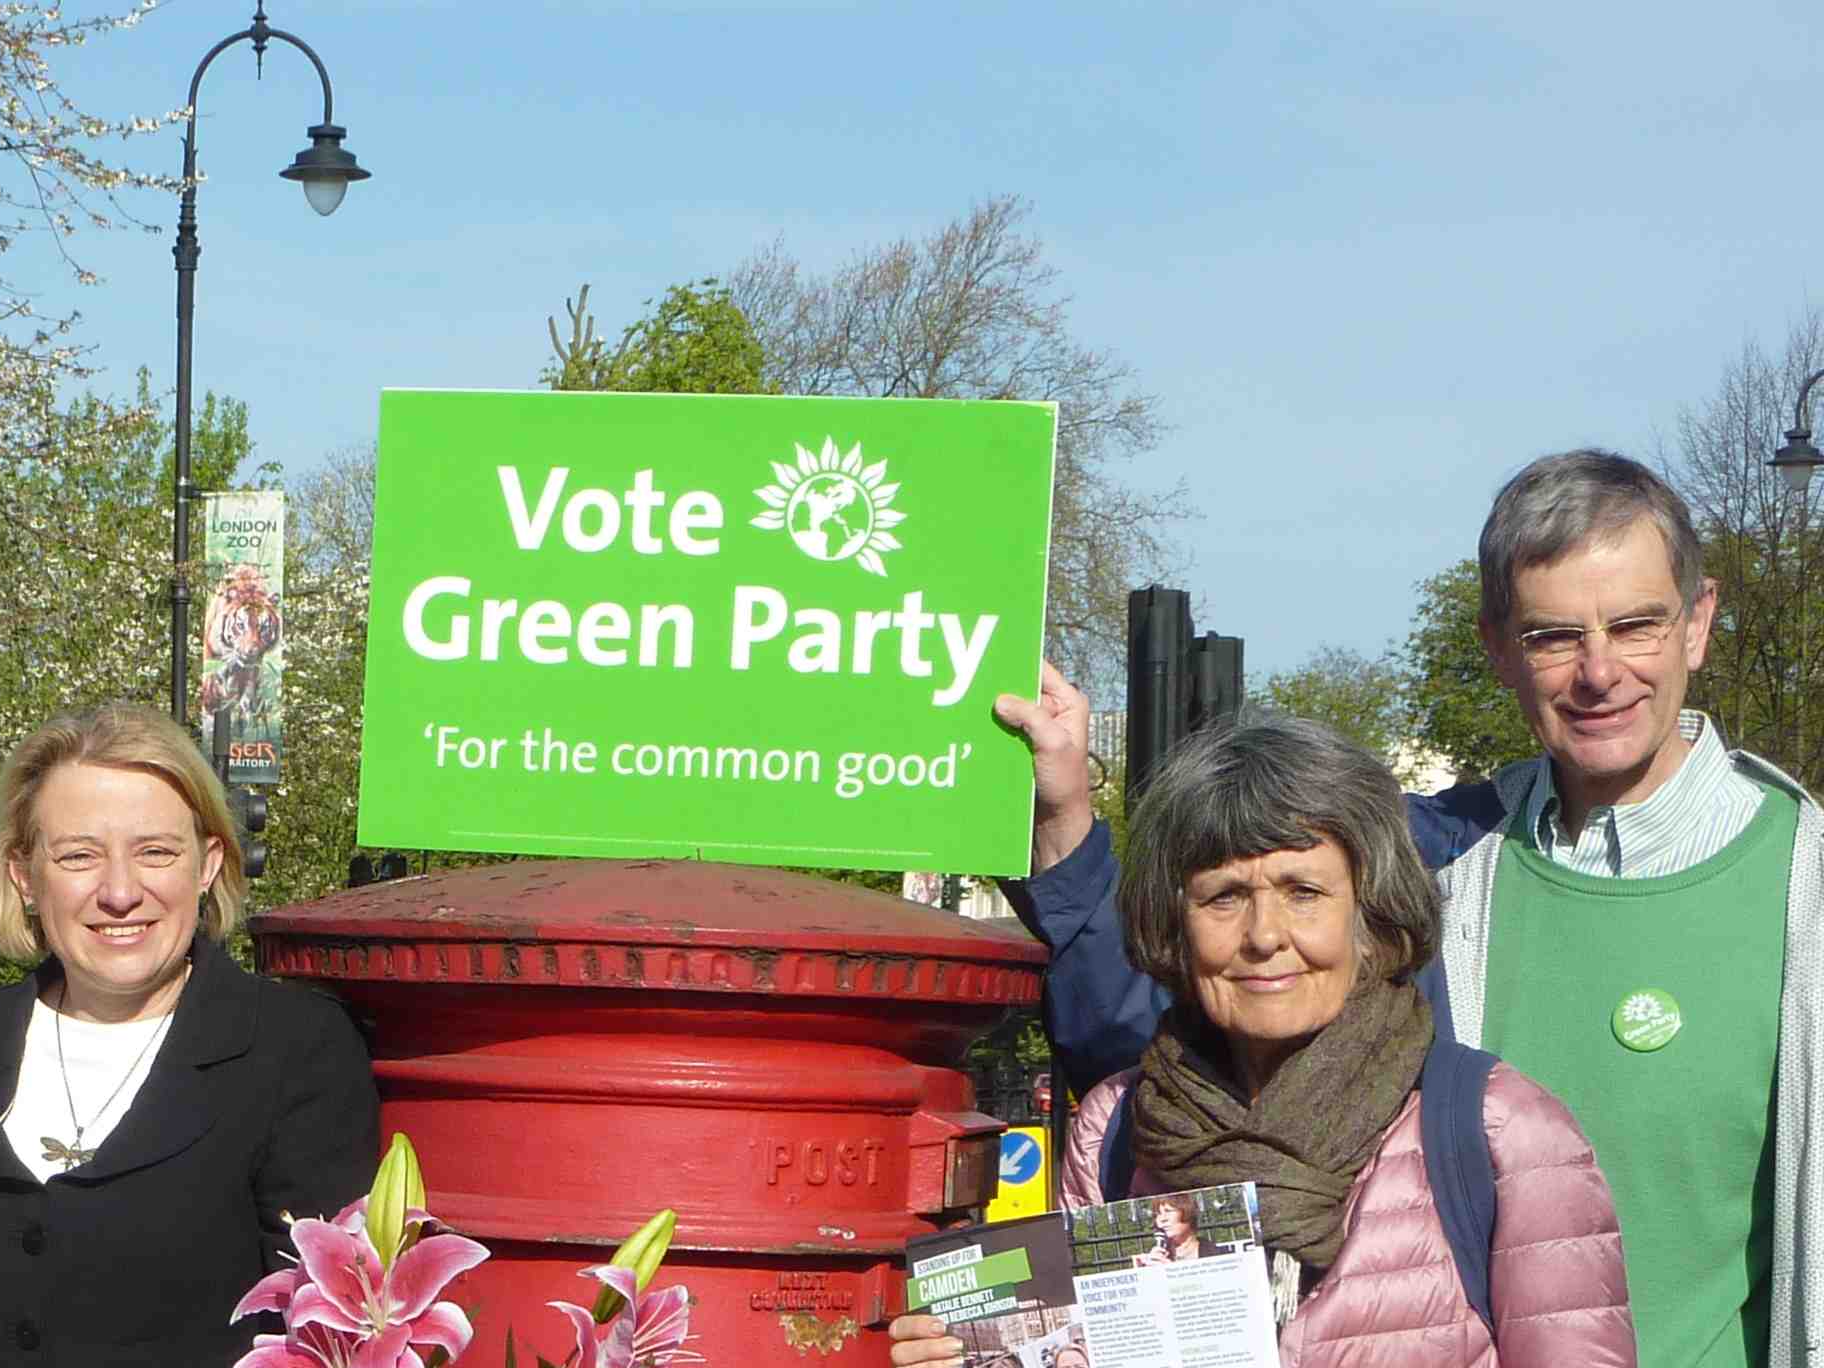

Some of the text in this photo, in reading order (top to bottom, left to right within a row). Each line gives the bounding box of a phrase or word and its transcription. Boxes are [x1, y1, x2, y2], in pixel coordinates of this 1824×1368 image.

[212, 519, 277, 533] LONDON
[497, 465, 725, 556] Vote
[227, 536, 262, 548] ZOO
[401, 575, 999, 707] Green Party
[229, 741, 276, 763] GER
[520, 727, 598, 774] the
[612, 743, 821, 783] common
[764, 1136, 885, 1186] POST
[917, 1248, 976, 1274] STANDING UP FOR
[919, 1265, 978, 1302] CAMDEN
[1091, 1273, 1138, 1288] INDEPENDENT
